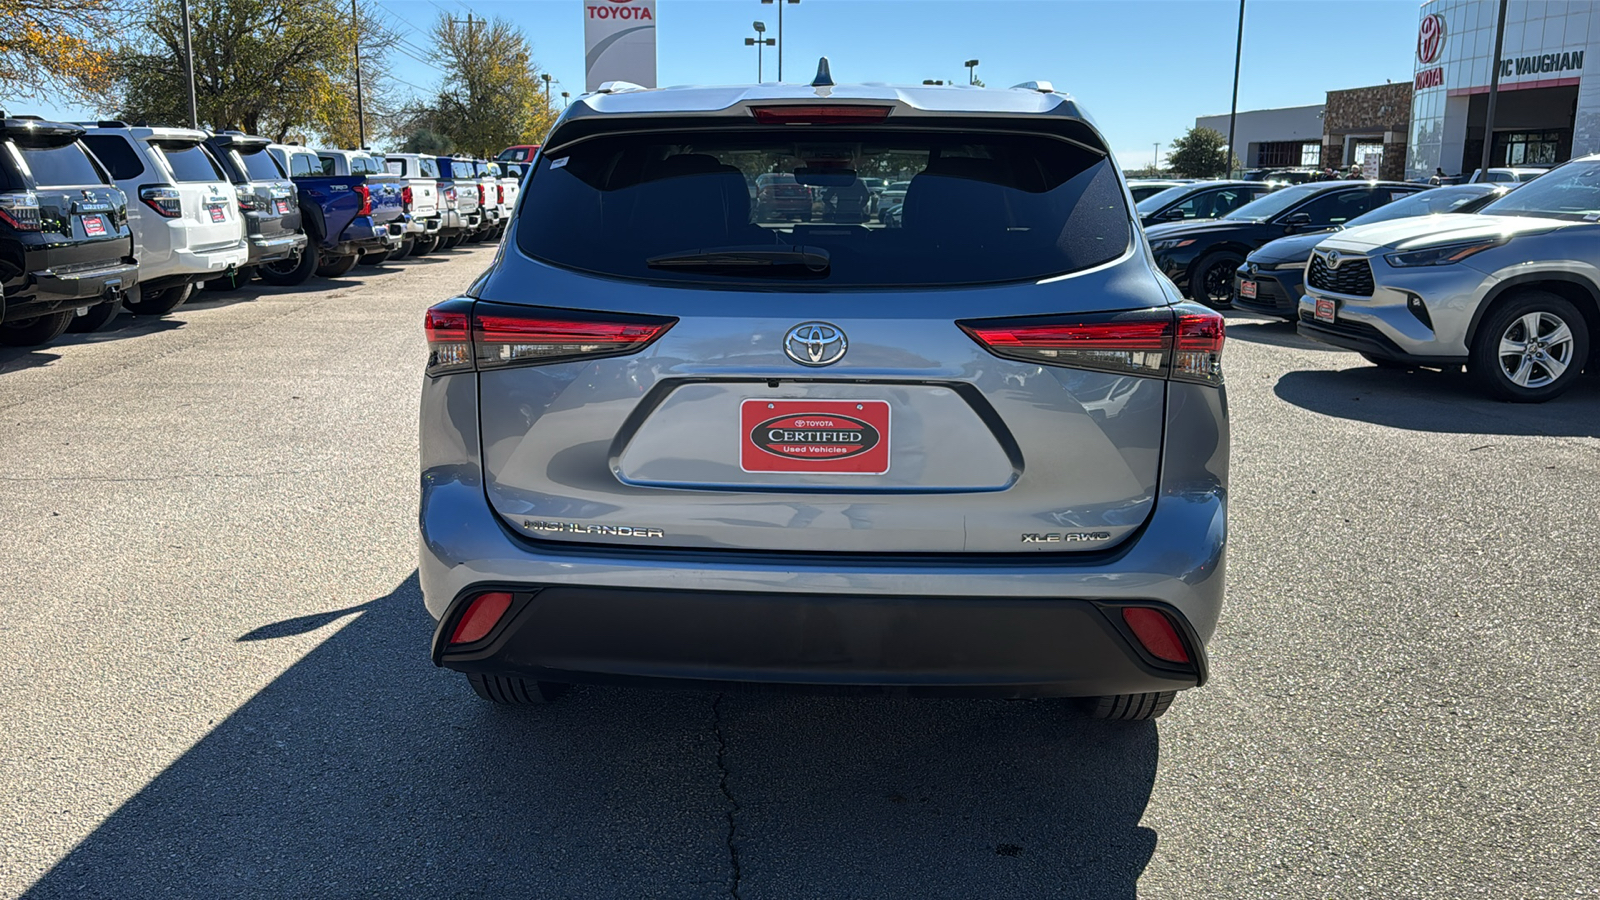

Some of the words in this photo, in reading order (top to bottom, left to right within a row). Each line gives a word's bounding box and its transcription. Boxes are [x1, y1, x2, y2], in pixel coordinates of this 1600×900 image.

[587, 6, 652, 20] TOYOTA
[1515, 51, 1584, 75] VAUGHAN
[768, 429, 862, 442] CERTIFIED
[809, 446, 847, 454] Vehicles
[524, 520, 664, 538] HIGHLANDER
[1022, 533, 1061, 543] XLE
[1065, 532, 1110, 542] AWD
